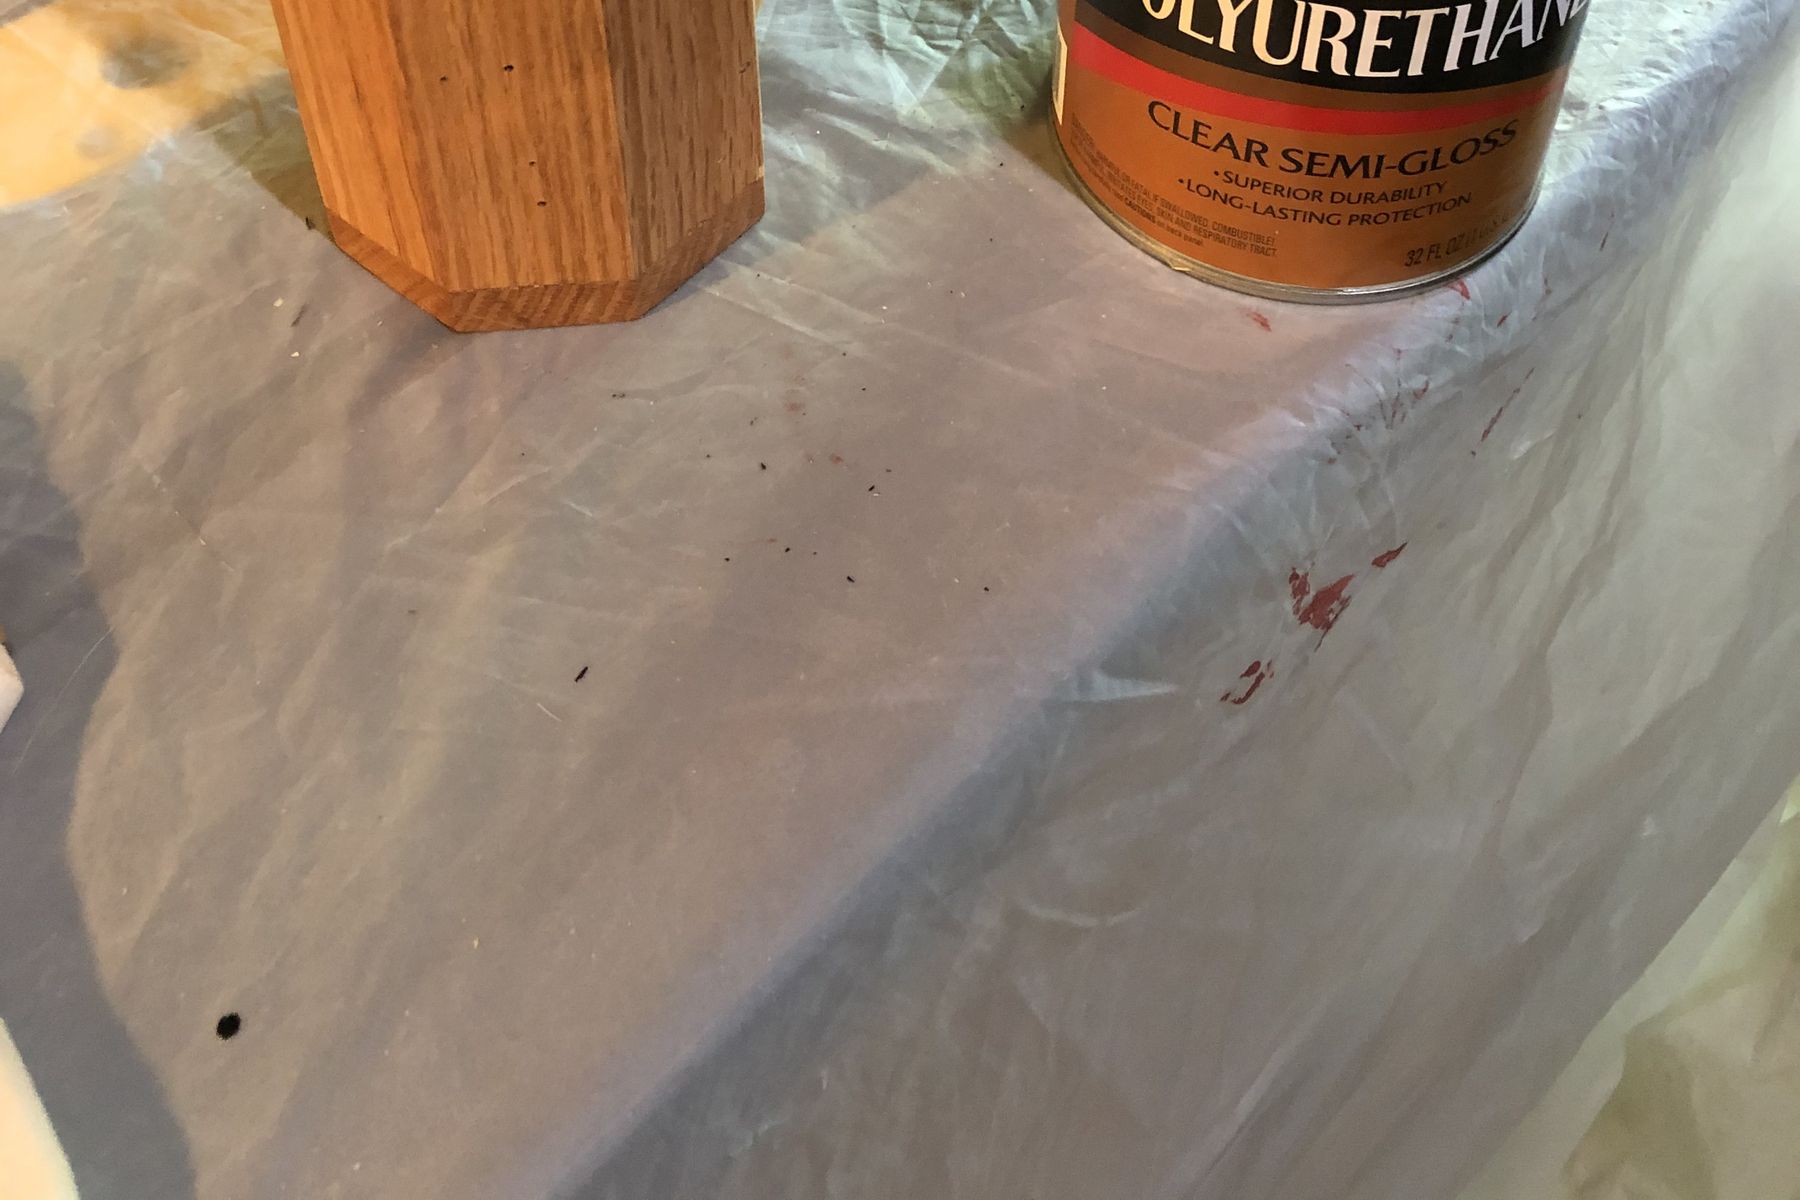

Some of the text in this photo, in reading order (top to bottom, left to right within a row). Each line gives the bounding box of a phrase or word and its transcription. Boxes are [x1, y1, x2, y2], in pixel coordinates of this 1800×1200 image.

[1147, 100, 1270, 169] CLEAR
[1278, 118, 1520, 179] SEMI-GLOSS
[1330, 181, 1449, 206] DURABILITY
[1347, 191, 1473, 227] PROTECTION
[1212, 220, 1275, 246] COMBUSTIBLE!
[1404, 246, 1425, 267] 32
[1427, 243, 1442, 263] FL
